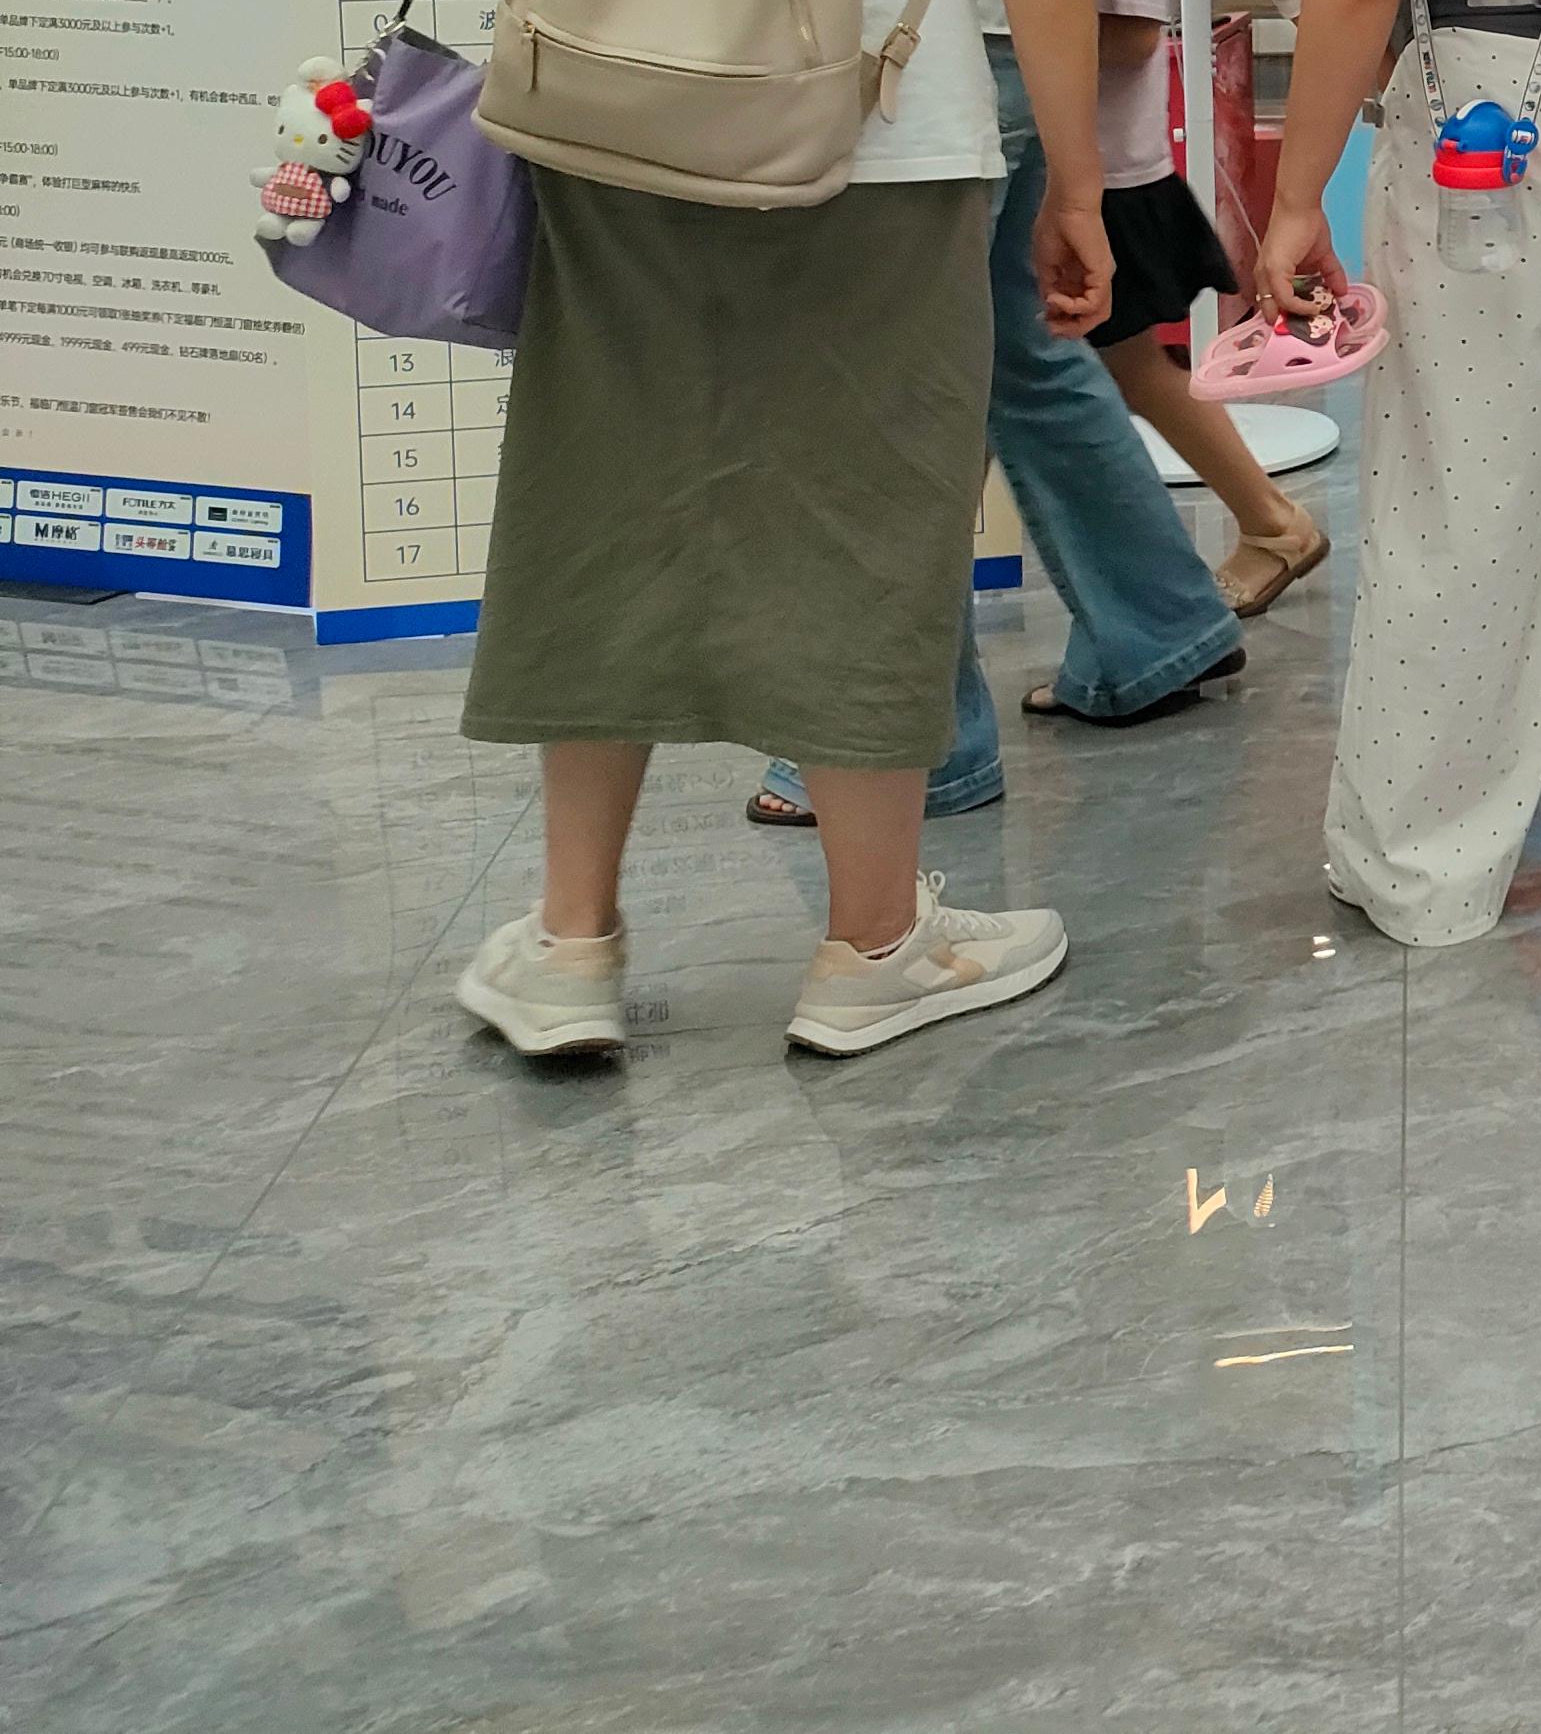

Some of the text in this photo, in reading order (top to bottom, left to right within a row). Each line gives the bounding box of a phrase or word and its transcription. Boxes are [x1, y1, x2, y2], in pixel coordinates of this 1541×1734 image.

[367, 133, 457, 201] UYOU
[371, 197, 409, 216] made
[389, 353, 415, 372] 13
[391, 401, 416, 420] 14
[393, 449, 418, 468] 15
[395, 497, 420, 516] 16
[397, 545, 421, 564] 17
